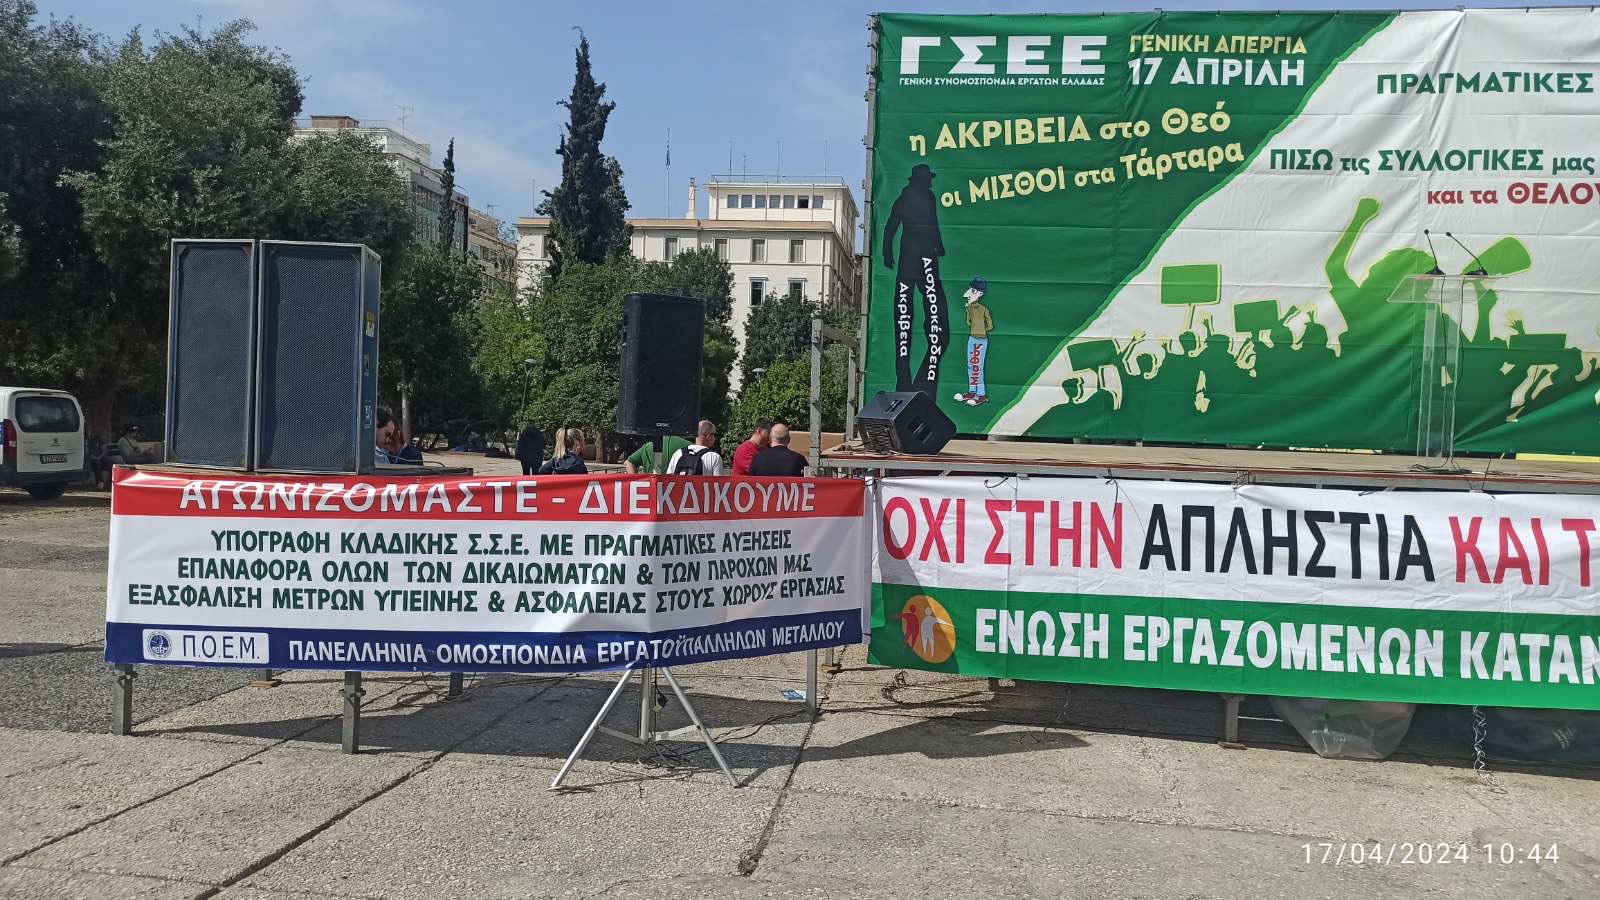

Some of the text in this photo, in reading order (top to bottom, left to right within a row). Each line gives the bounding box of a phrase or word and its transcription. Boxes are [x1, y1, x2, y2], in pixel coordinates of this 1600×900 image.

[900, 35, 1107, 75] ΓΣΕΕ
[1129, 33, 1307, 55] ΓΕΝΙΚΗ ΑΠΕΡΓΙΑ
[899, 77, 1105, 86] ΓΕΝΙΚΗ ΣΥΝΟΜΟΣΠΟΝΔΙΑ ΕΡΓΑΤΩΝ ΕΛΛΑΔΑΣ
[1127, 57, 1305, 86] 17 ΑΠΡΙΛΗ
[1376, 71, 1594, 94] ΠΡΑΓΜΑΤΙΚΕΣ
[909, 101, 1231, 156] η ΑΚΡΙΒΕΙΑ στο Θεό
[940, 142, 1245, 208] οι ΜΙΣΘΟΙ στα Τάρταρα
[1269, 148, 1595, 175] ΠΙΣΩ τις ΣΥΛΛΟΓΙΚΕΣ μας
[1427, 182, 1600, 205] και τα ΘΕΛΟ
[898, 282, 911, 357] Ακρίβεια
[922, 257, 942, 381] Αισχροκέρδεια
[180, 479, 538, 513] ΑΓΩΝΙΖΟΜΑΣΤΕ
[577, 480, 817, 515] ΔΙΕΚΔΙΚΟΥΜΕ
[211, 530, 792, 557] ΥΠΟΓΡΑΦΗ ΚΛΑΔΙΚΗΣ Σ.Σ.Ε. ΜΕ ΠΡΑΓΜΑΤΙΚΕΣ ΑΥΞΗΣΕΙΣ
[882, 496, 966, 564] ΟΧΙ
[984, 499, 1123, 569] ΣΤΗΝ
[1139, 503, 1436, 582] ΑΠΛΗΣΤΙΑ
[1448, 516, 1550, 586] ΚΑΙ
[177, 553, 813, 585] ΕΠΑΝΑΦΟΡΑ ΟΛΩΝ ΤΩΝ ΔΙΚΑΙΩΜΑΤΩΝ & ΤΩΝ ΠΑΡΟΧΩΝ ΜΑΣ
[128, 576, 846, 614] ΕΞΑΣΦΑΛΙΣΗ ΜΕΤΡΩΝ ΥΓΙΕΙΝΗΣ & ΑΣΦΑΛΕΙΑΣ ΣΤΟΥΣ ΧΩΡΟΥΣ ΕΡΓΑΣΙΑΣ
[183, 635, 260, 659] Π.Ο.Ε.Μ.
[289, 640, 428, 664] ΠΑΝΕΛΛΗΝΙΑ
[436, 643, 588, 666] ΟΜΟΣΠΟΝΔΙΑ
[772, 620, 846, 646] ΜΕΤΑΛΛΟΥ
[975, 608, 1109, 659] ΕΝΩΣΗ
[1123, 614, 1444, 678] ΕΡΓΑΖΟΜΕΝΩΝ
